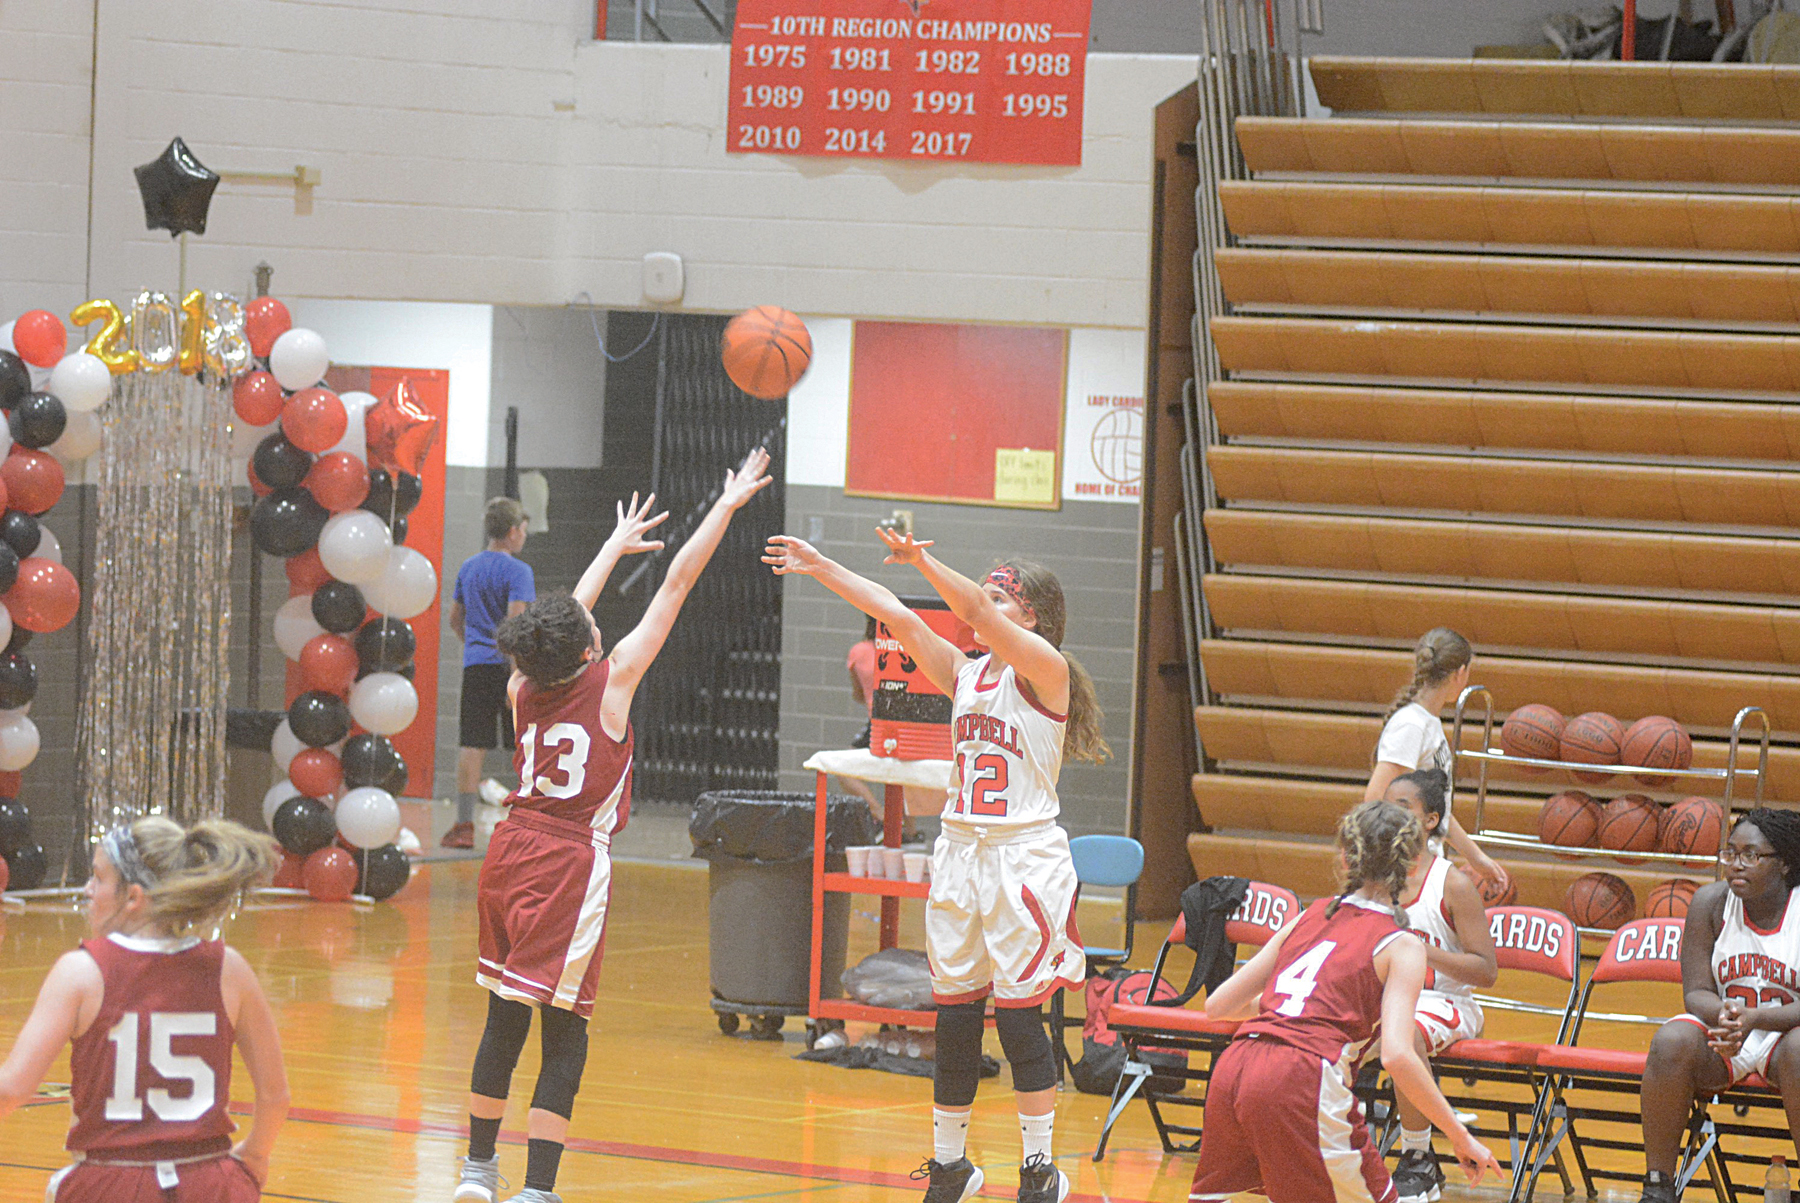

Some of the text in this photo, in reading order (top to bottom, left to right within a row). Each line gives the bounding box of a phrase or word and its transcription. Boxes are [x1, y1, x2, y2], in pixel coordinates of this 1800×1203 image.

[769, 16, 1053, 44] 10TH REGION CHAMPIONS
[743, 45, 1071, 77] 1975 1981 1982 1988
[741, 85, 1068, 118] 1989 1990 1991 1995
[738, 125, 973, 156] 2010 2014 2017
[69, 288, 252, 376] 2018
[1088, 395, 1109, 406] LADY
[1075, 483, 1101, 495] HOME
[1105, 485, 1115, 496] OF
[955, 712, 1023, 760] MPBELL
[517, 722, 591, 800] 13
[954, 753, 1009, 817] 12
[1489, 913, 1565, 959] ARDS
[1615, 924, 1682, 963] CAR
[1274, 940, 1337, 1018] 4
[1718, 952, 1800, 993] CAMPBELL
[103, 1011, 216, 1122] 15
